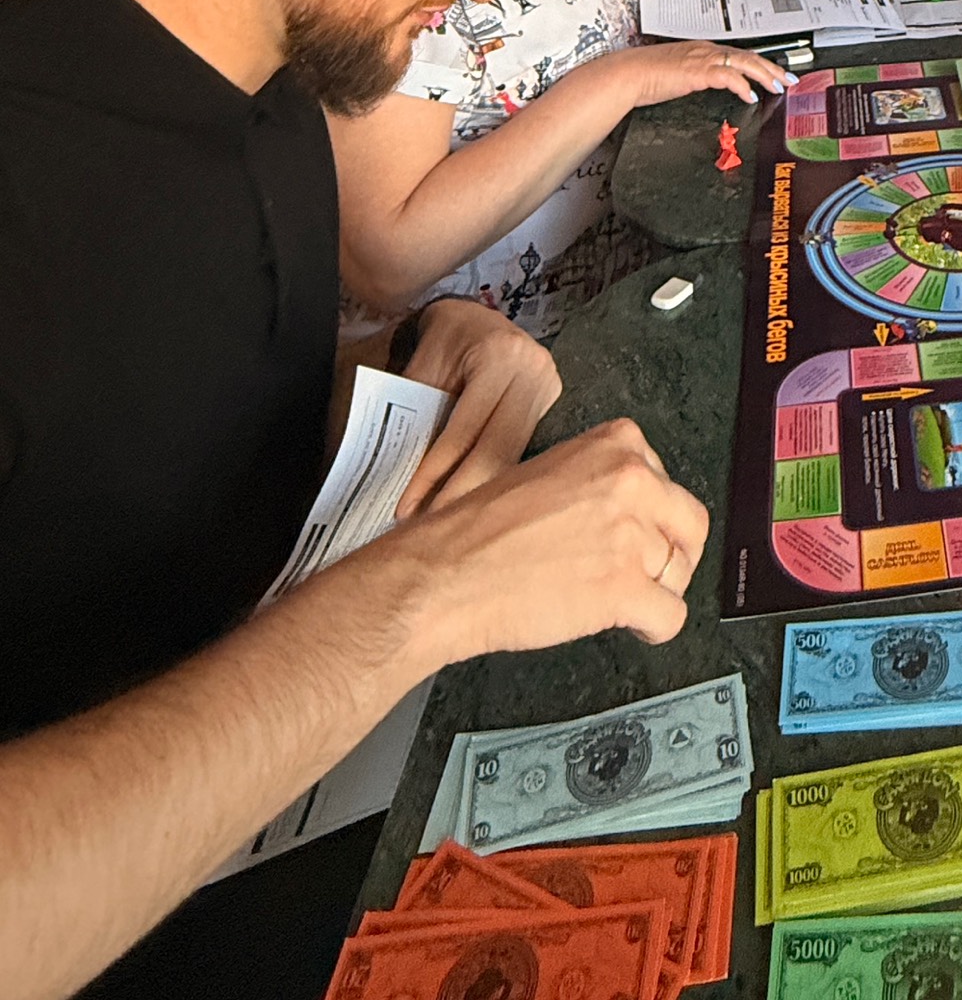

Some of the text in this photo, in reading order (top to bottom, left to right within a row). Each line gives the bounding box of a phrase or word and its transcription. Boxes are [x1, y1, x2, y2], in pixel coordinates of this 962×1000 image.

[765, 162, 796, 364] Как вырваться из крысиных бегов
[798, 633, 826, 649] 500
[716, 689, 731, 702] 10
[718, 741, 739, 760] 10
[476, 758, 498, 777] 10
[788, 784, 830, 807] 1000
[473, 825, 490, 840] 10
[788, 867, 820, 884] 1000
[789, 938, 837, 961] 5000
